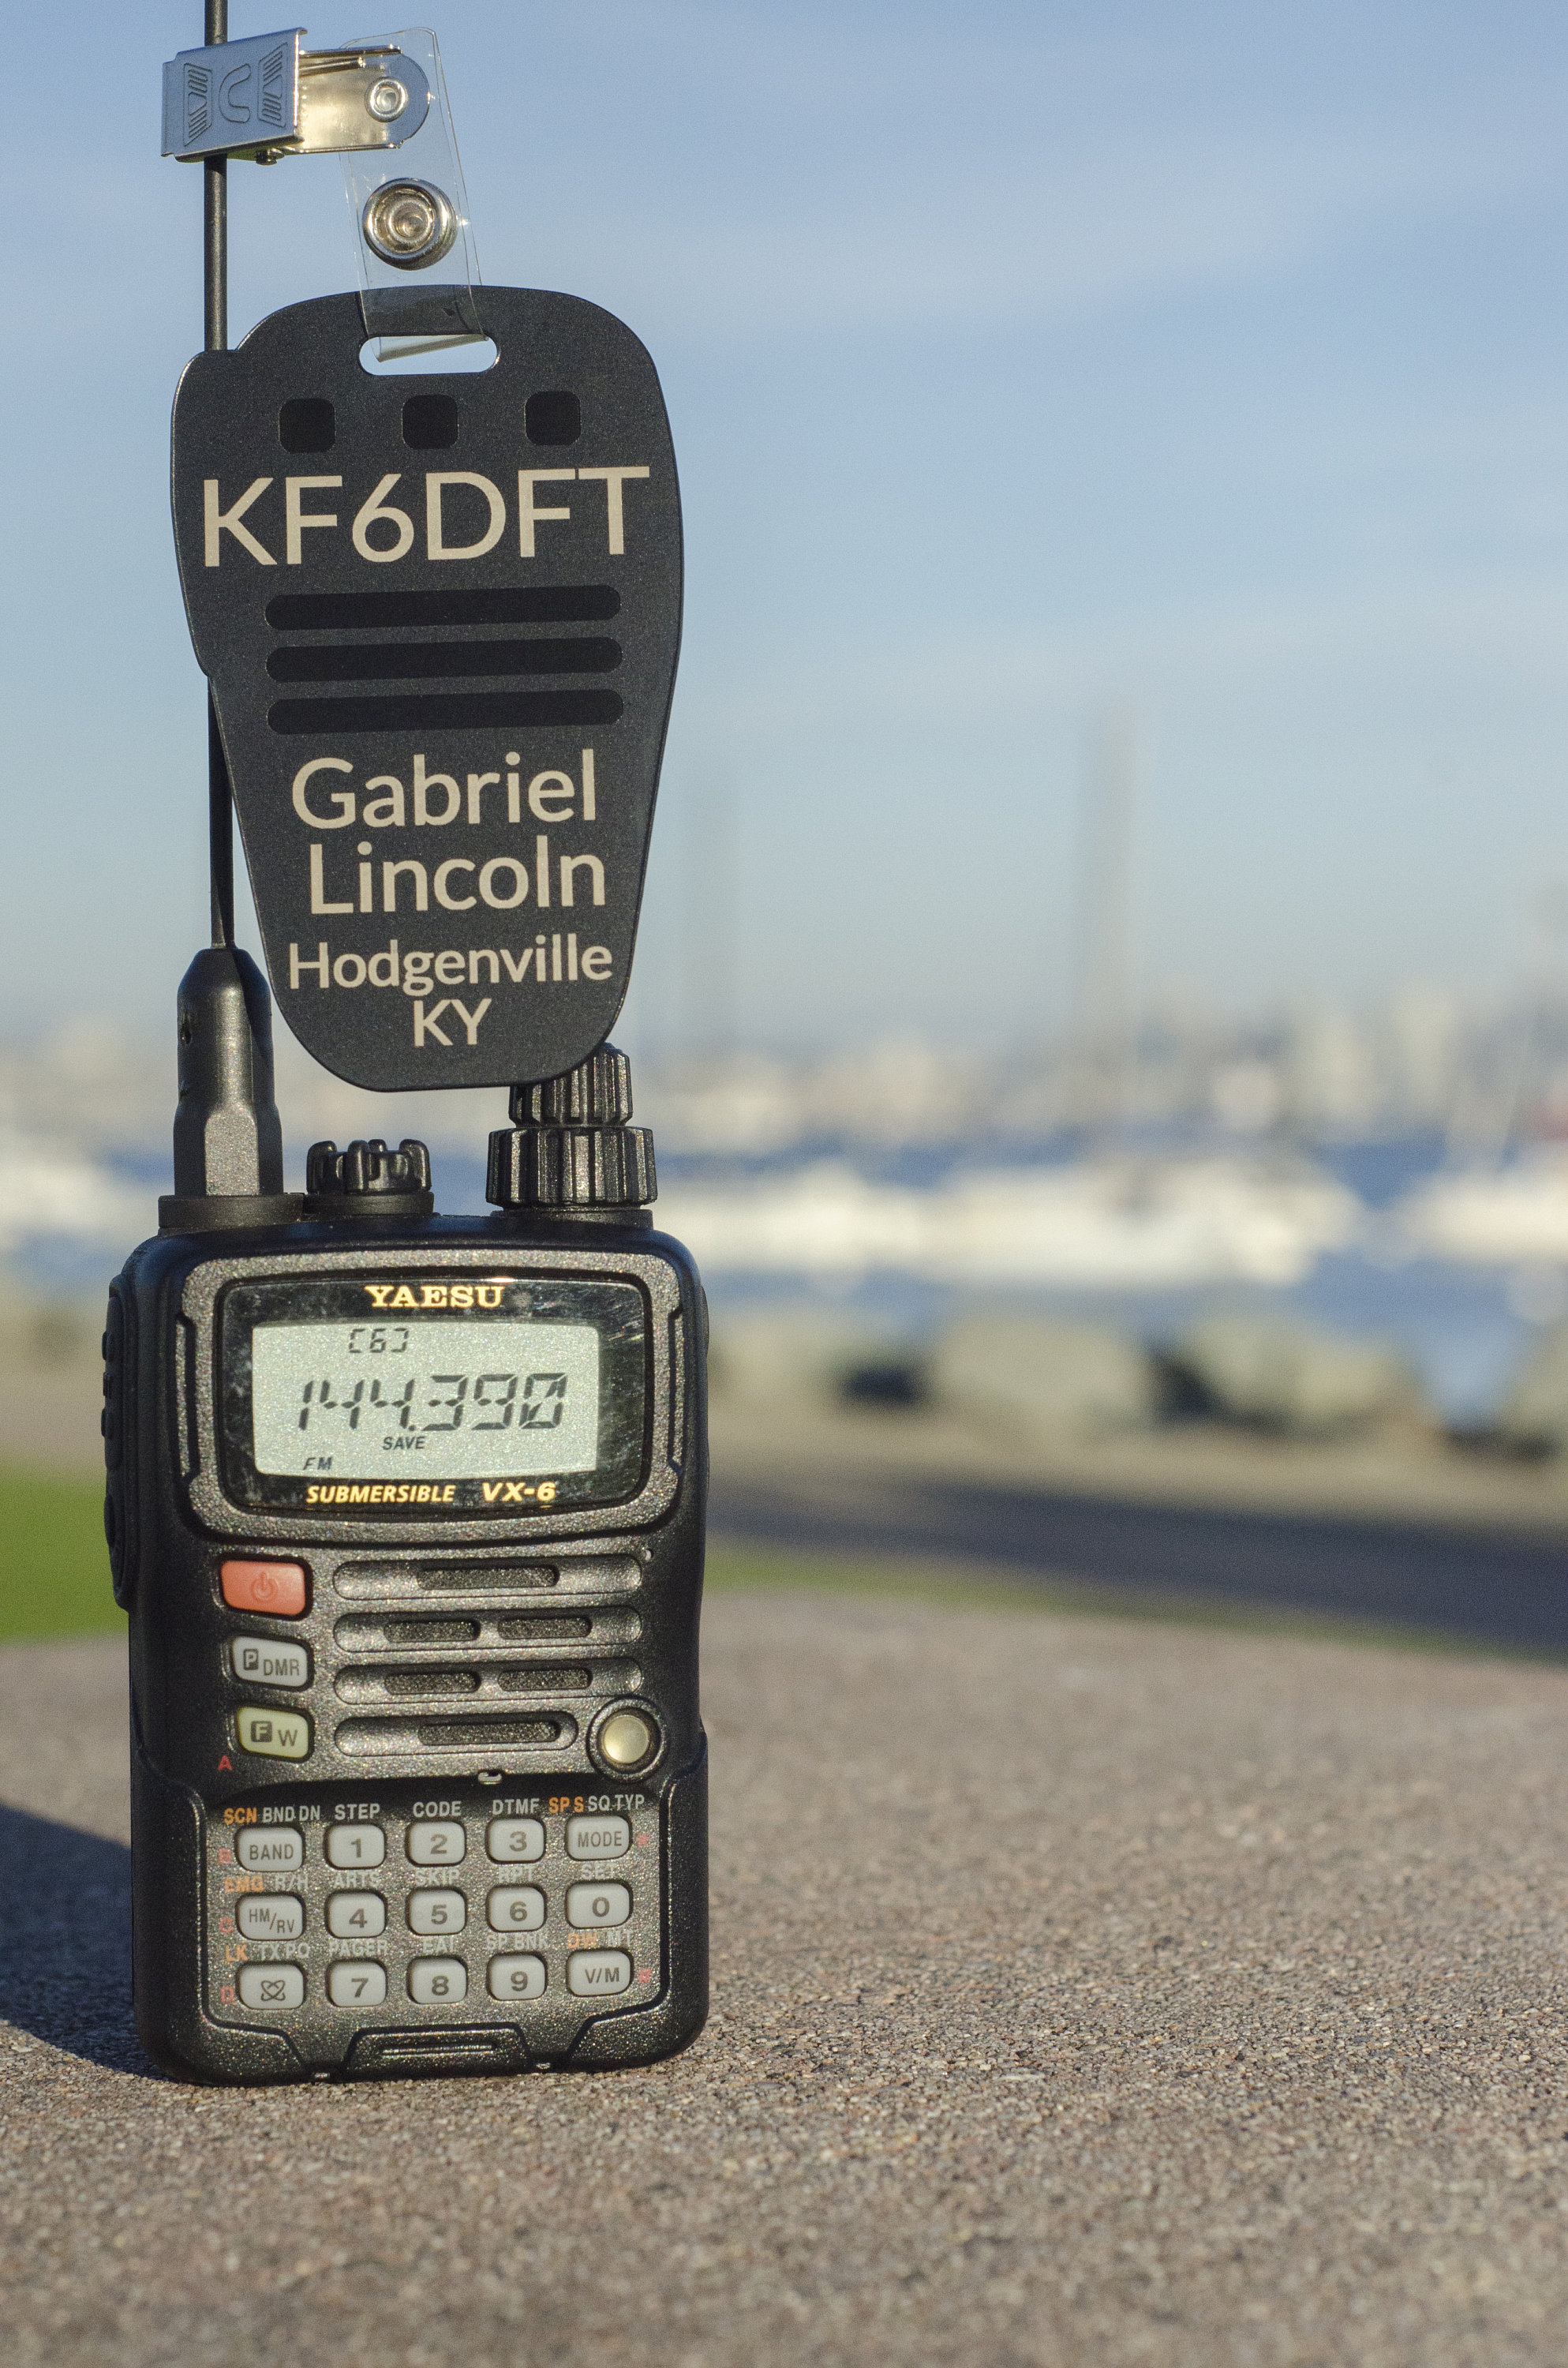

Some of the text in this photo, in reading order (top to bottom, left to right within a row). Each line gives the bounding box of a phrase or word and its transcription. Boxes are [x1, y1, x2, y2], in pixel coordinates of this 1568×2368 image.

[203, 466, 650, 568] KF6DFT
[292, 748, 597, 829] Gabriel
[309, 834, 606, 916] Lincoln
[289, 934, 612, 997] Hodgenville
[414, 998, 492, 1047] KY
[364, 1285, 504, 1308] YAESU
[298, 1372, 567, 1432] 144.390
[382, 1436, 425, 1451] SAVE
[302, 1457, 332, 1471] FM
[305, 1481, 556, 1503] SUBMERSIBLE VX-6
[263, 1658, 300, 1677] DMR
[279, 1729, 298, 1747] W
[217, 1755, 233, 1771] A
[223, 1804, 320, 1825] SCN BND DN
[335, 1803, 380, 1820] STEP
[413, 1800, 462, 1818] CODE
[492, 1797, 540, 1815] DTMF
[350, 1838, 362, 1858] 1
[430, 1834, 448, 1854] 2
[509, 1830, 528, 1852] 3
[577, 1830, 623, 1849] MODE
[249, 1843, 294, 1860] BAND
[224, 1875, 264, 1893] EMG
[349, 1908, 368, 1928] 4
[431, 1904, 448, 1924] 5
[509, 1901, 528, 1922] 6
[329, 1939, 389, 1958] PAGER
[431, 1974, 449, 1995] 8
[510, 1971, 529, 1991] 9
[585, 1967, 619, 1984] V/M
[221, 1986, 234, 2003] D
[351, 1976, 369, 1998] 7
